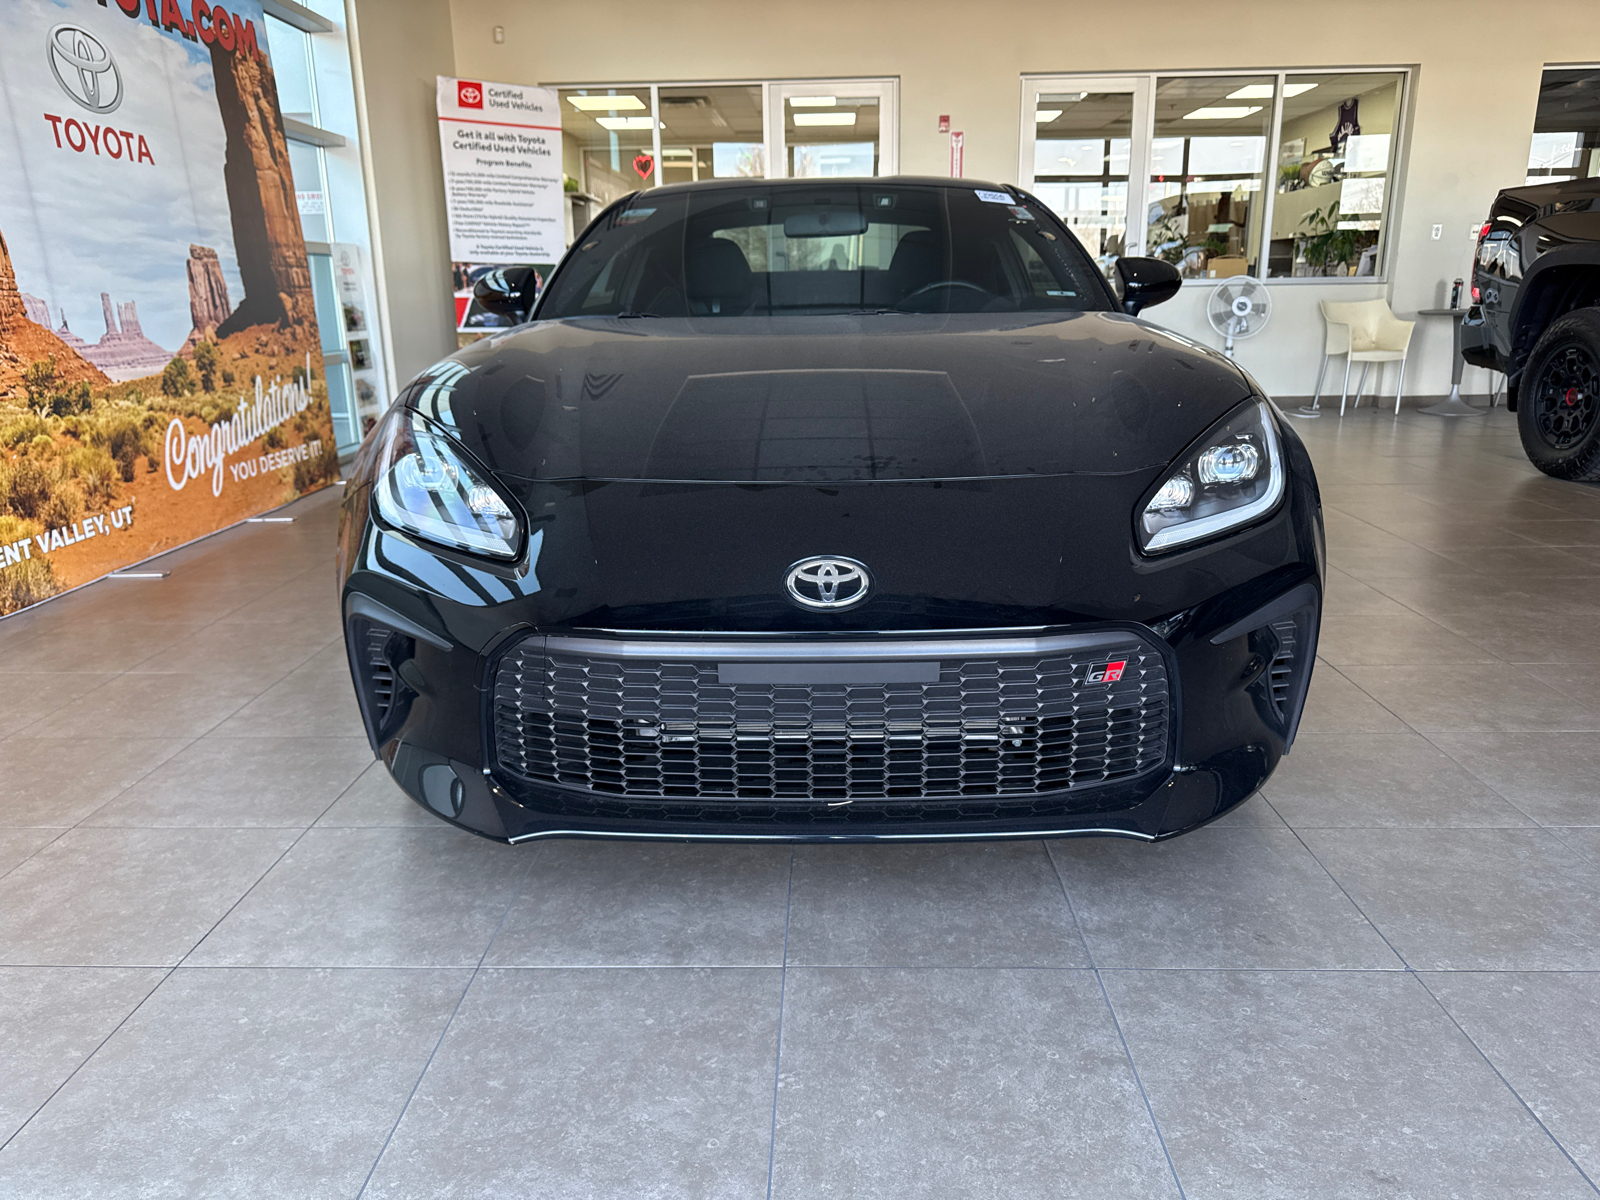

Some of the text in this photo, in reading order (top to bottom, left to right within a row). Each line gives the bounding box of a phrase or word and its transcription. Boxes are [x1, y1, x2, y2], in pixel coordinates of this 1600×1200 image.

[488, 88, 524, 100] Certified
[489, 99, 543, 112] Used Vehicles
[43, 113, 156, 166] TOYOTA
[457, 129, 546, 146] Get it all with Toyota
[452, 141, 551, 156] Certified Used Vehicles
[164, 351, 314, 498] Congratulations!
[229, 439, 324, 483] YOU DESERVE IT!
[35, 513, 110, 554] VALLEY,
[110, 505, 133, 529] UT
[1088, 669, 1121, 682] GR
